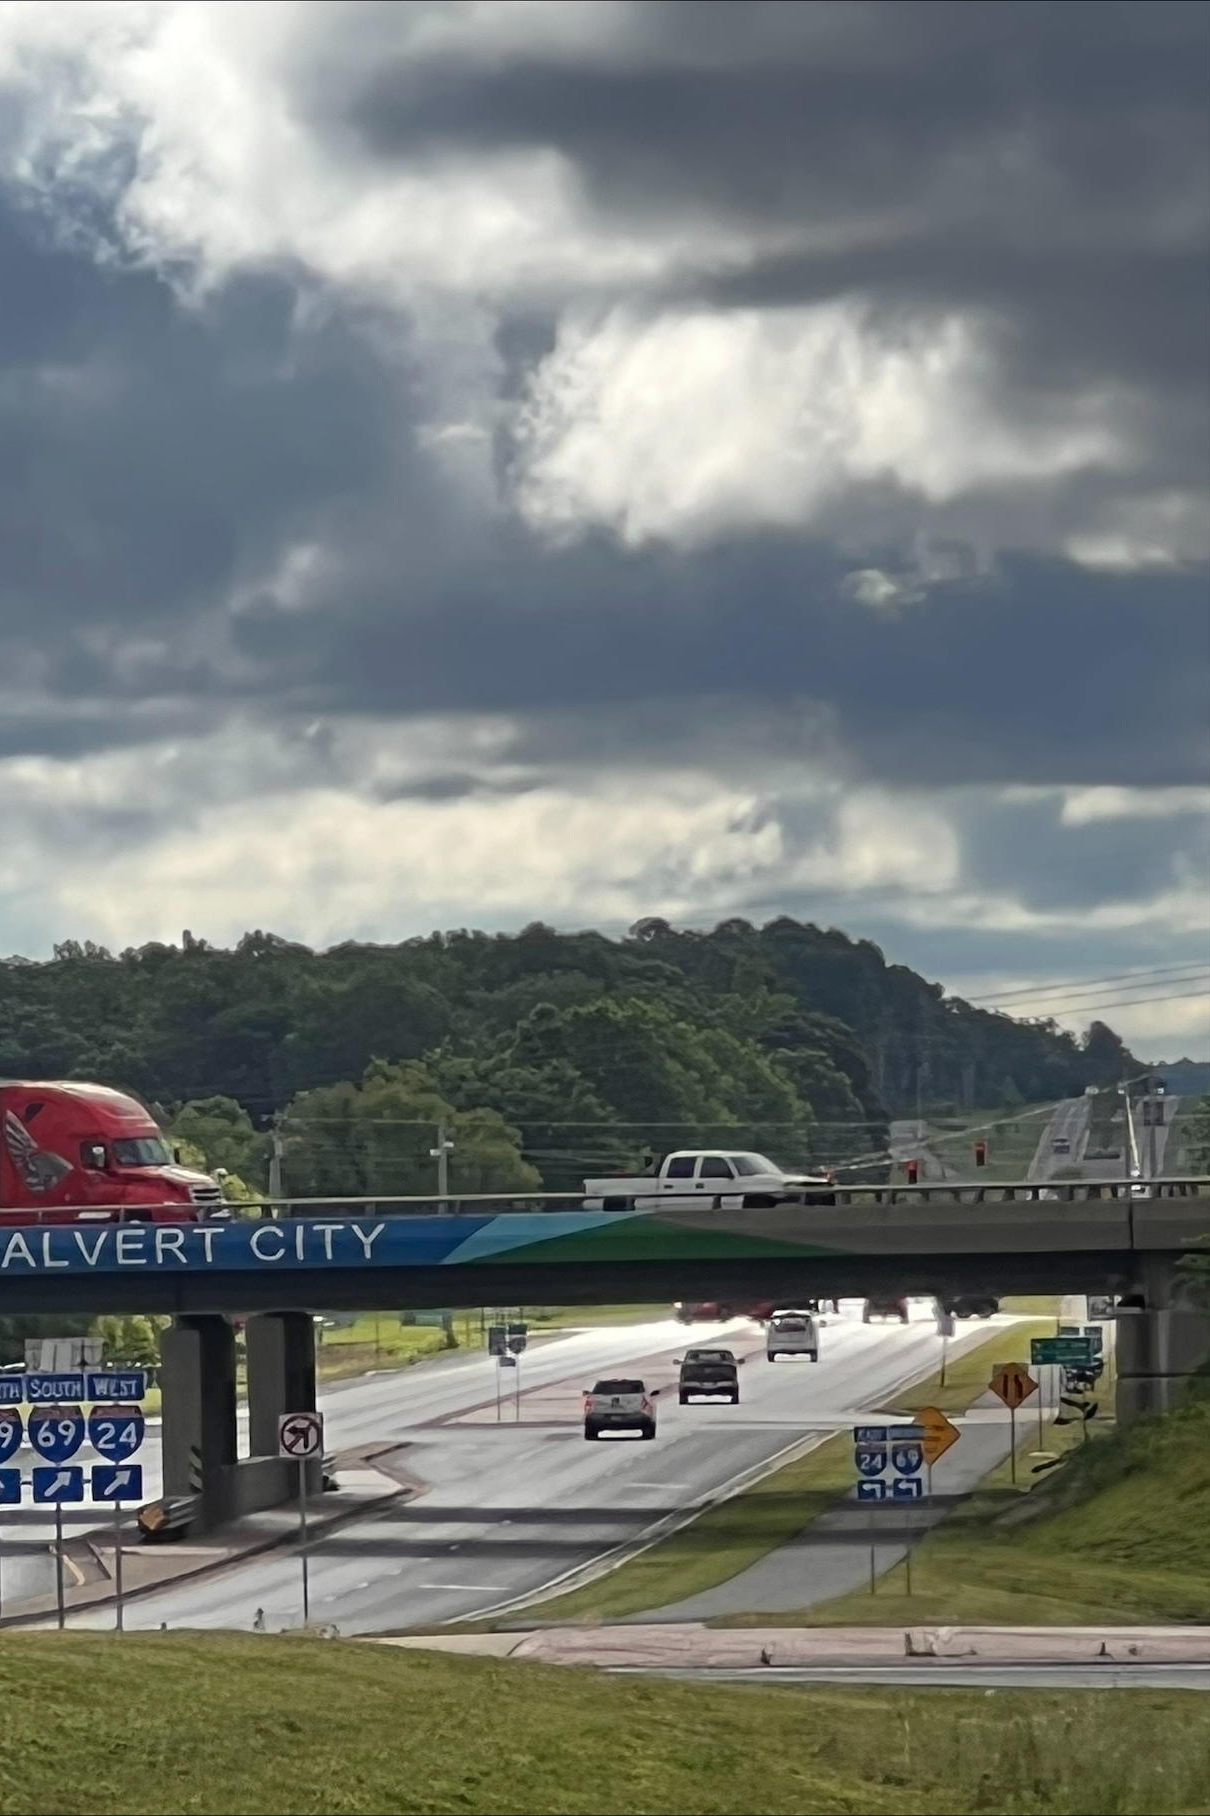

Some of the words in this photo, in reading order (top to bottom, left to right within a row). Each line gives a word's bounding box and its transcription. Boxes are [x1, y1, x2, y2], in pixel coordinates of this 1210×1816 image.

[250, 1223, 386, 1262] CITY
[30, 1379, 82, 1398] SOUTH
[93, 1379, 137, 1397] WEST
[37, 1419, 77, 1447] 69
[96, 1421, 138, 1449] 24
[859, 1453, 883, 1470] 24
